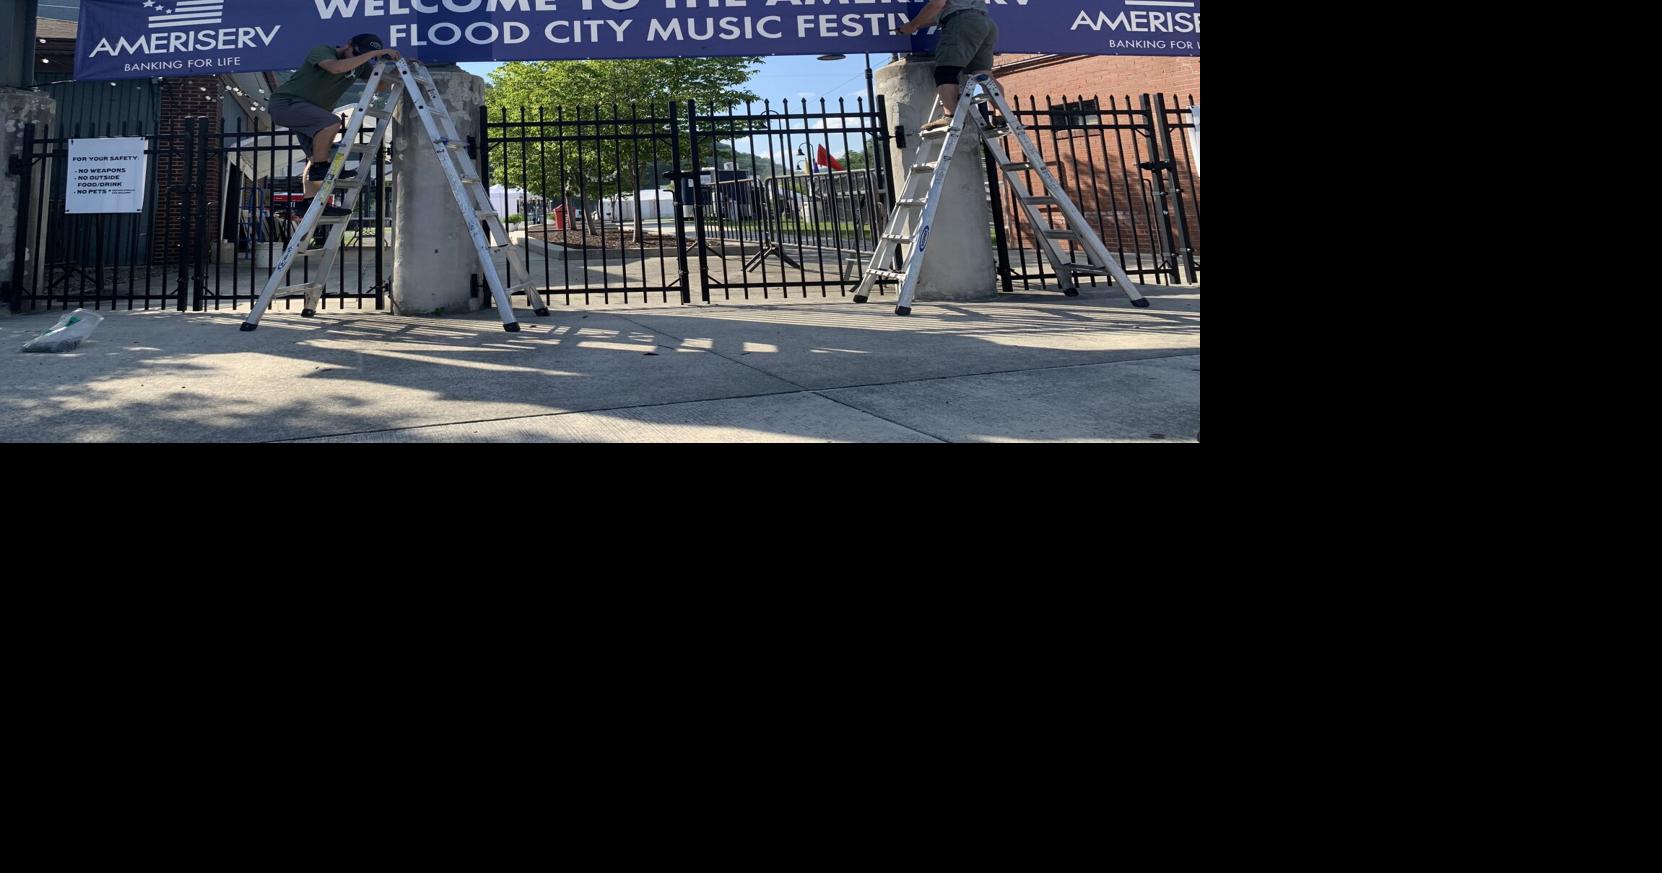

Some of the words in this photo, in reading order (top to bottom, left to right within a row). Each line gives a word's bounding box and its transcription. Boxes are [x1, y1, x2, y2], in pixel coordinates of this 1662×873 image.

[89, 25, 281, 58] AMERISERV
[390, 21, 530, 47] FLOOD
[544, 20, 632, 43] CITY
[647, 15, 782, 41] MUSIC
[1109, 39, 1166, 49] BANKING
[1170, 40, 1193, 49] FOR
[124, 61, 183, 72] BANKING
[187, 59, 213, 68] FOR
[217, 57, 241, 67] LIFE
